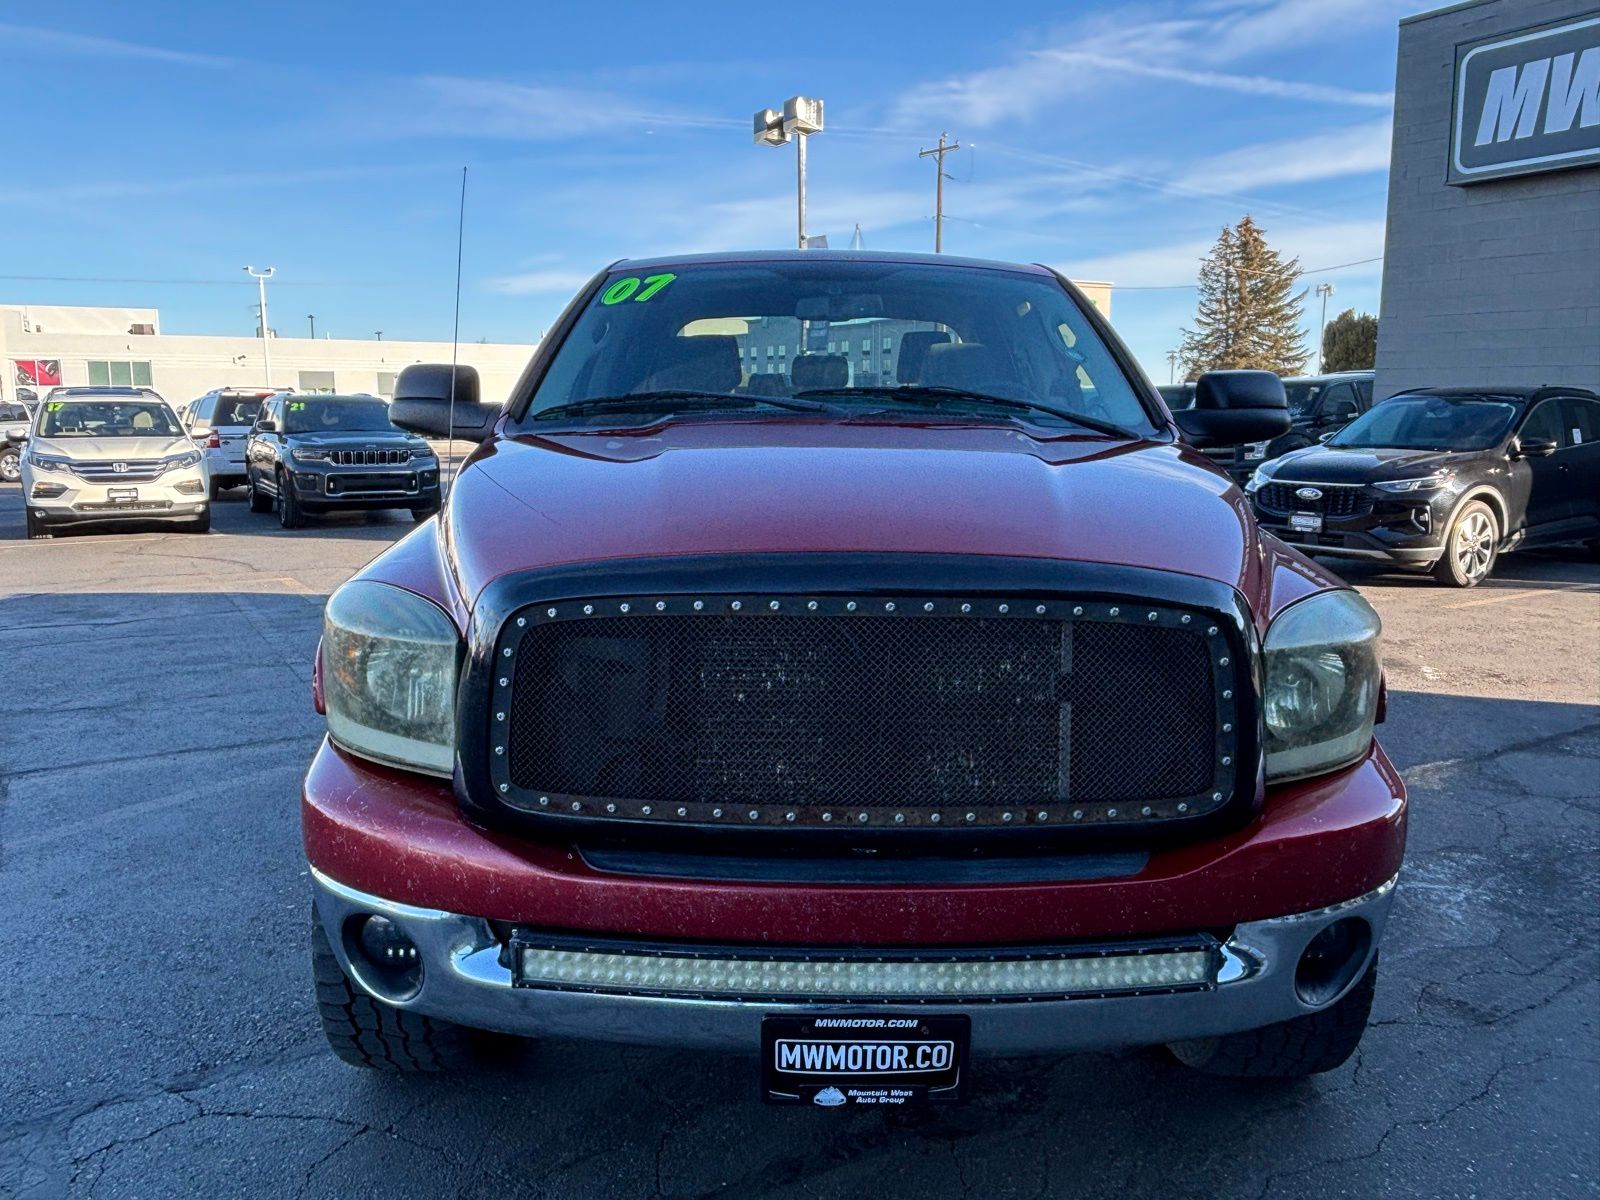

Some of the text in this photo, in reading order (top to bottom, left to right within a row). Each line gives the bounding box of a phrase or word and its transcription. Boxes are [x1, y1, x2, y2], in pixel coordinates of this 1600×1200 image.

[601, 273, 677, 305] 07
[290, 402, 305, 411] 21
[814, 1018, 918, 1028] MWMOTOR.COM
[781, 1043, 948, 1070] MWMOTOR.CO
[848, 1089, 888, 1097] Mountain
[879, 1096, 905, 1105] Group
